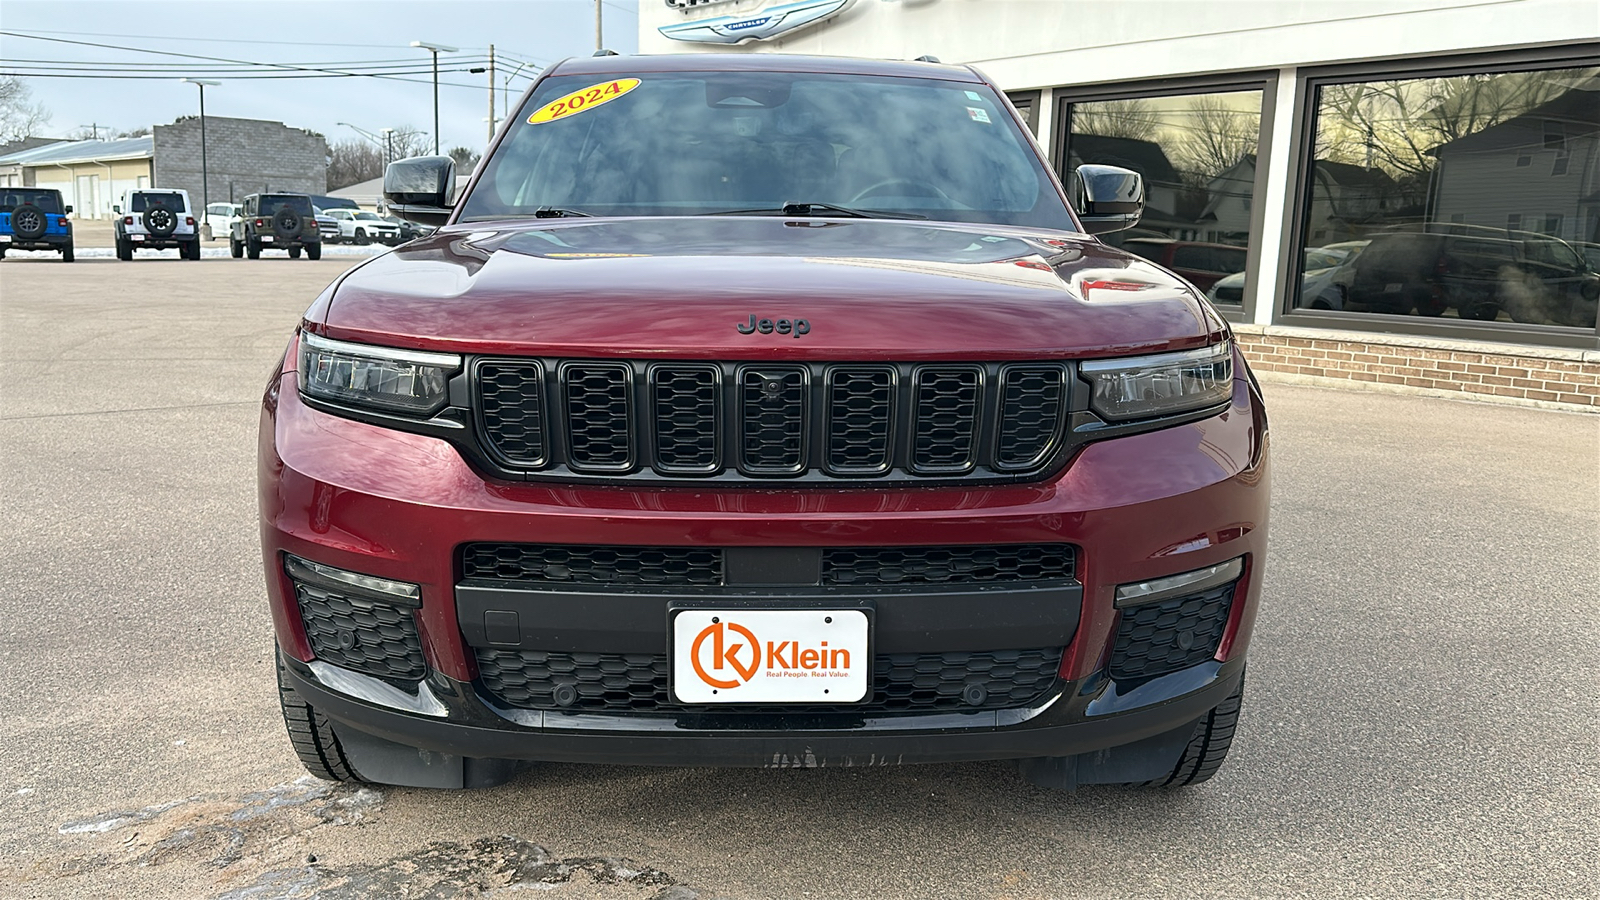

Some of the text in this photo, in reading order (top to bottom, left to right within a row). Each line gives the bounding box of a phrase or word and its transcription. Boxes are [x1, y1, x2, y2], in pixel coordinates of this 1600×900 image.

[727, 19, 766, 30] CHRYSLER
[549, 82, 623, 118] 2024
[737, 314, 811, 338] Jeep
[766, 641, 851, 669] Klein
[783, 671, 809, 679] People.
